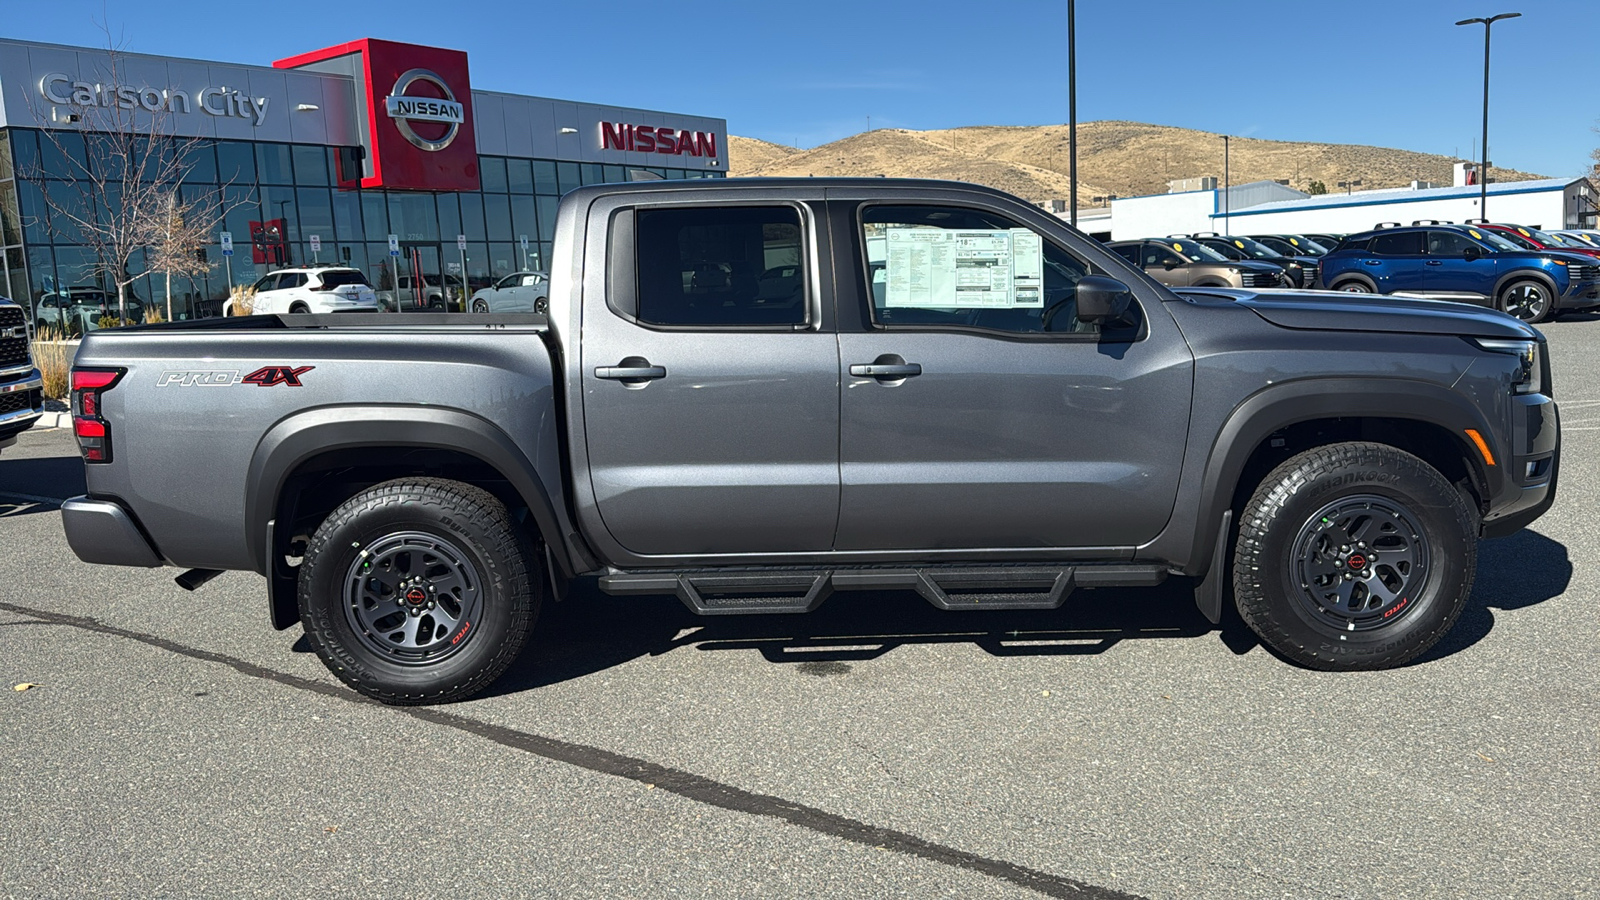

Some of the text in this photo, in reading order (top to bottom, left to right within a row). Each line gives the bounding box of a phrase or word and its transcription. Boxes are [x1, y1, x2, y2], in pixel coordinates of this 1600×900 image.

[39, 72, 270, 126] Carson City
[397, 101, 459, 119] NISSAN
[599, 121, 717, 158] NISSAN
[407, 233, 424, 241] 2750
[1383, 597, 1407, 618] PRO
[452, 621, 471, 645] PRO
